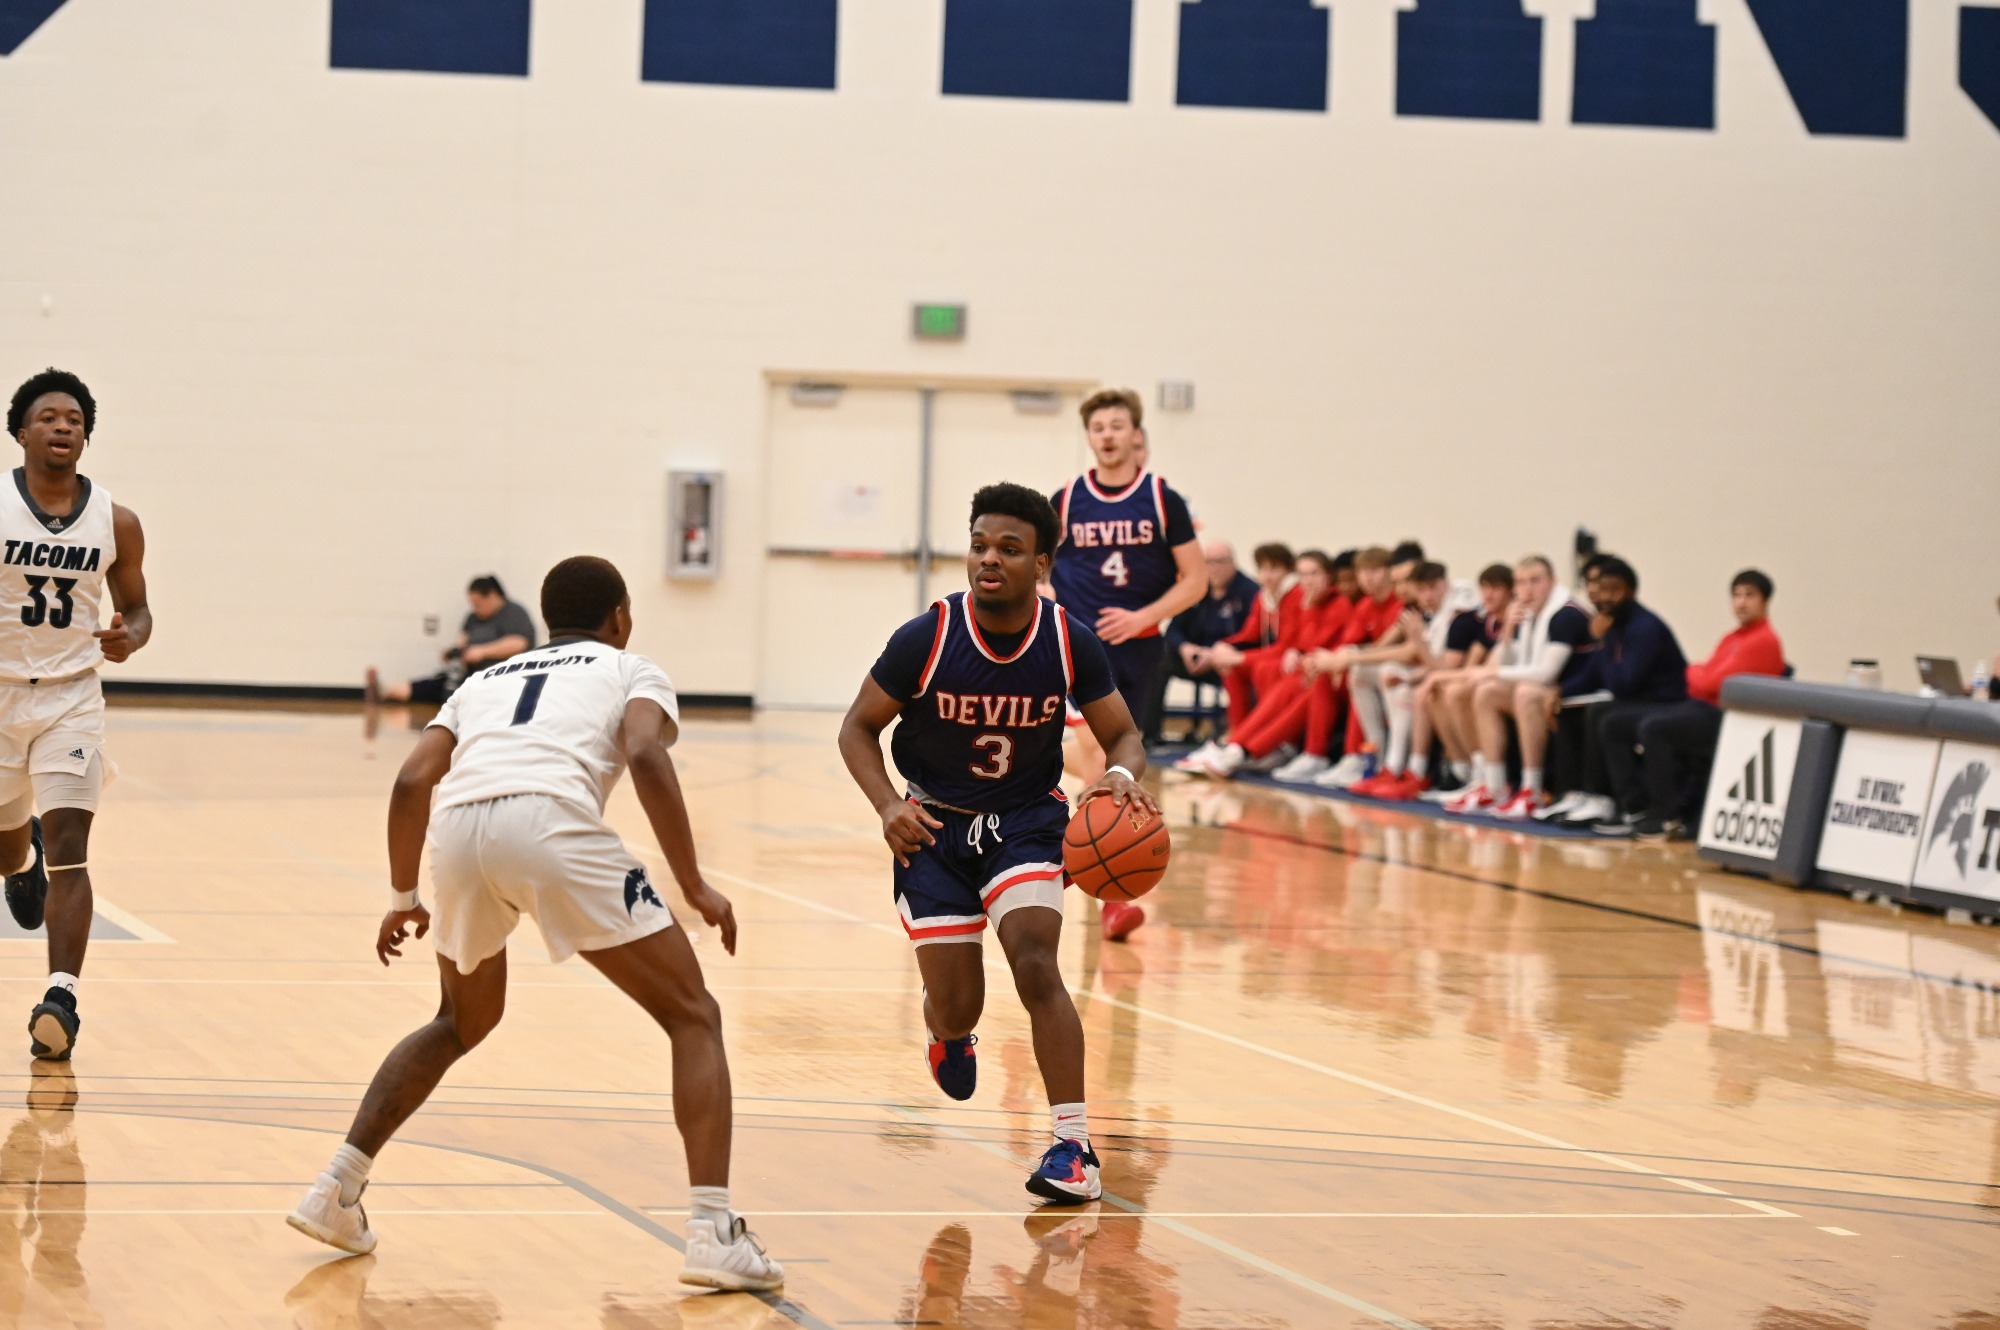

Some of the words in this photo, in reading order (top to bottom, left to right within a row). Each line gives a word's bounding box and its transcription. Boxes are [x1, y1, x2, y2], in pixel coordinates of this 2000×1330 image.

[1071, 519, 1153, 548] DEVILS
[3, 539, 101, 573] TACOMA
[1101, 550, 1130, 588] 4
[20, 573, 78, 630] 33
[483, 655, 598, 681] COMMUNITY
[508, 672, 549, 728] 1
[936, 691, 1061, 728] DEVILS
[968, 732, 1014, 781] 3
[1713, 802, 1782, 849] adidas
